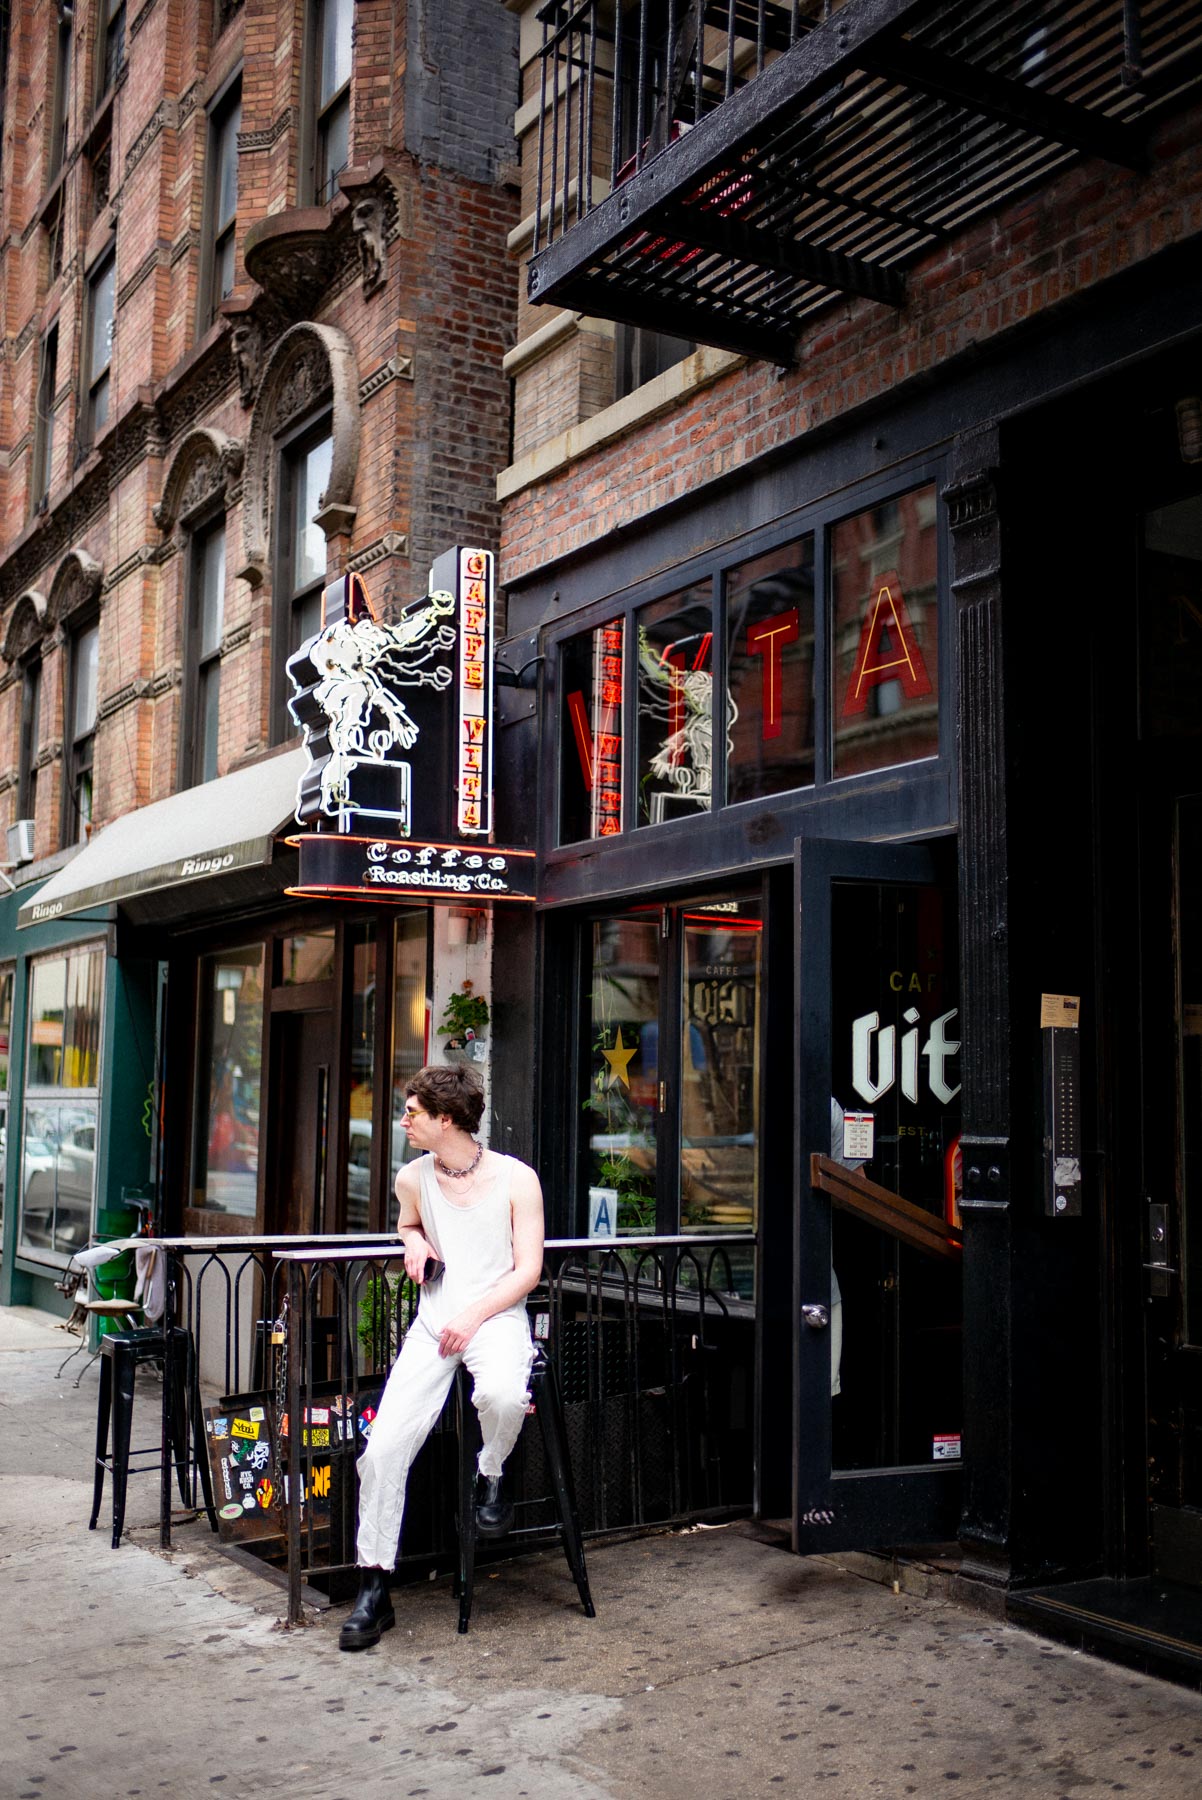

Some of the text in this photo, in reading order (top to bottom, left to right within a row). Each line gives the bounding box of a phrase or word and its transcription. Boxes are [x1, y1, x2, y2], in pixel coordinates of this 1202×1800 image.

[464, 548, 487, 828] CAFFE VITA
[181, 853, 234, 876] Ringo
[367, 842, 508, 871] Coffee
[369, 865, 508, 892] Roasting Co.
[32, 902, 63, 920] Ringo
[705, 965, 739, 976] CAFFE
[594, 1197, 611, 1236] A
